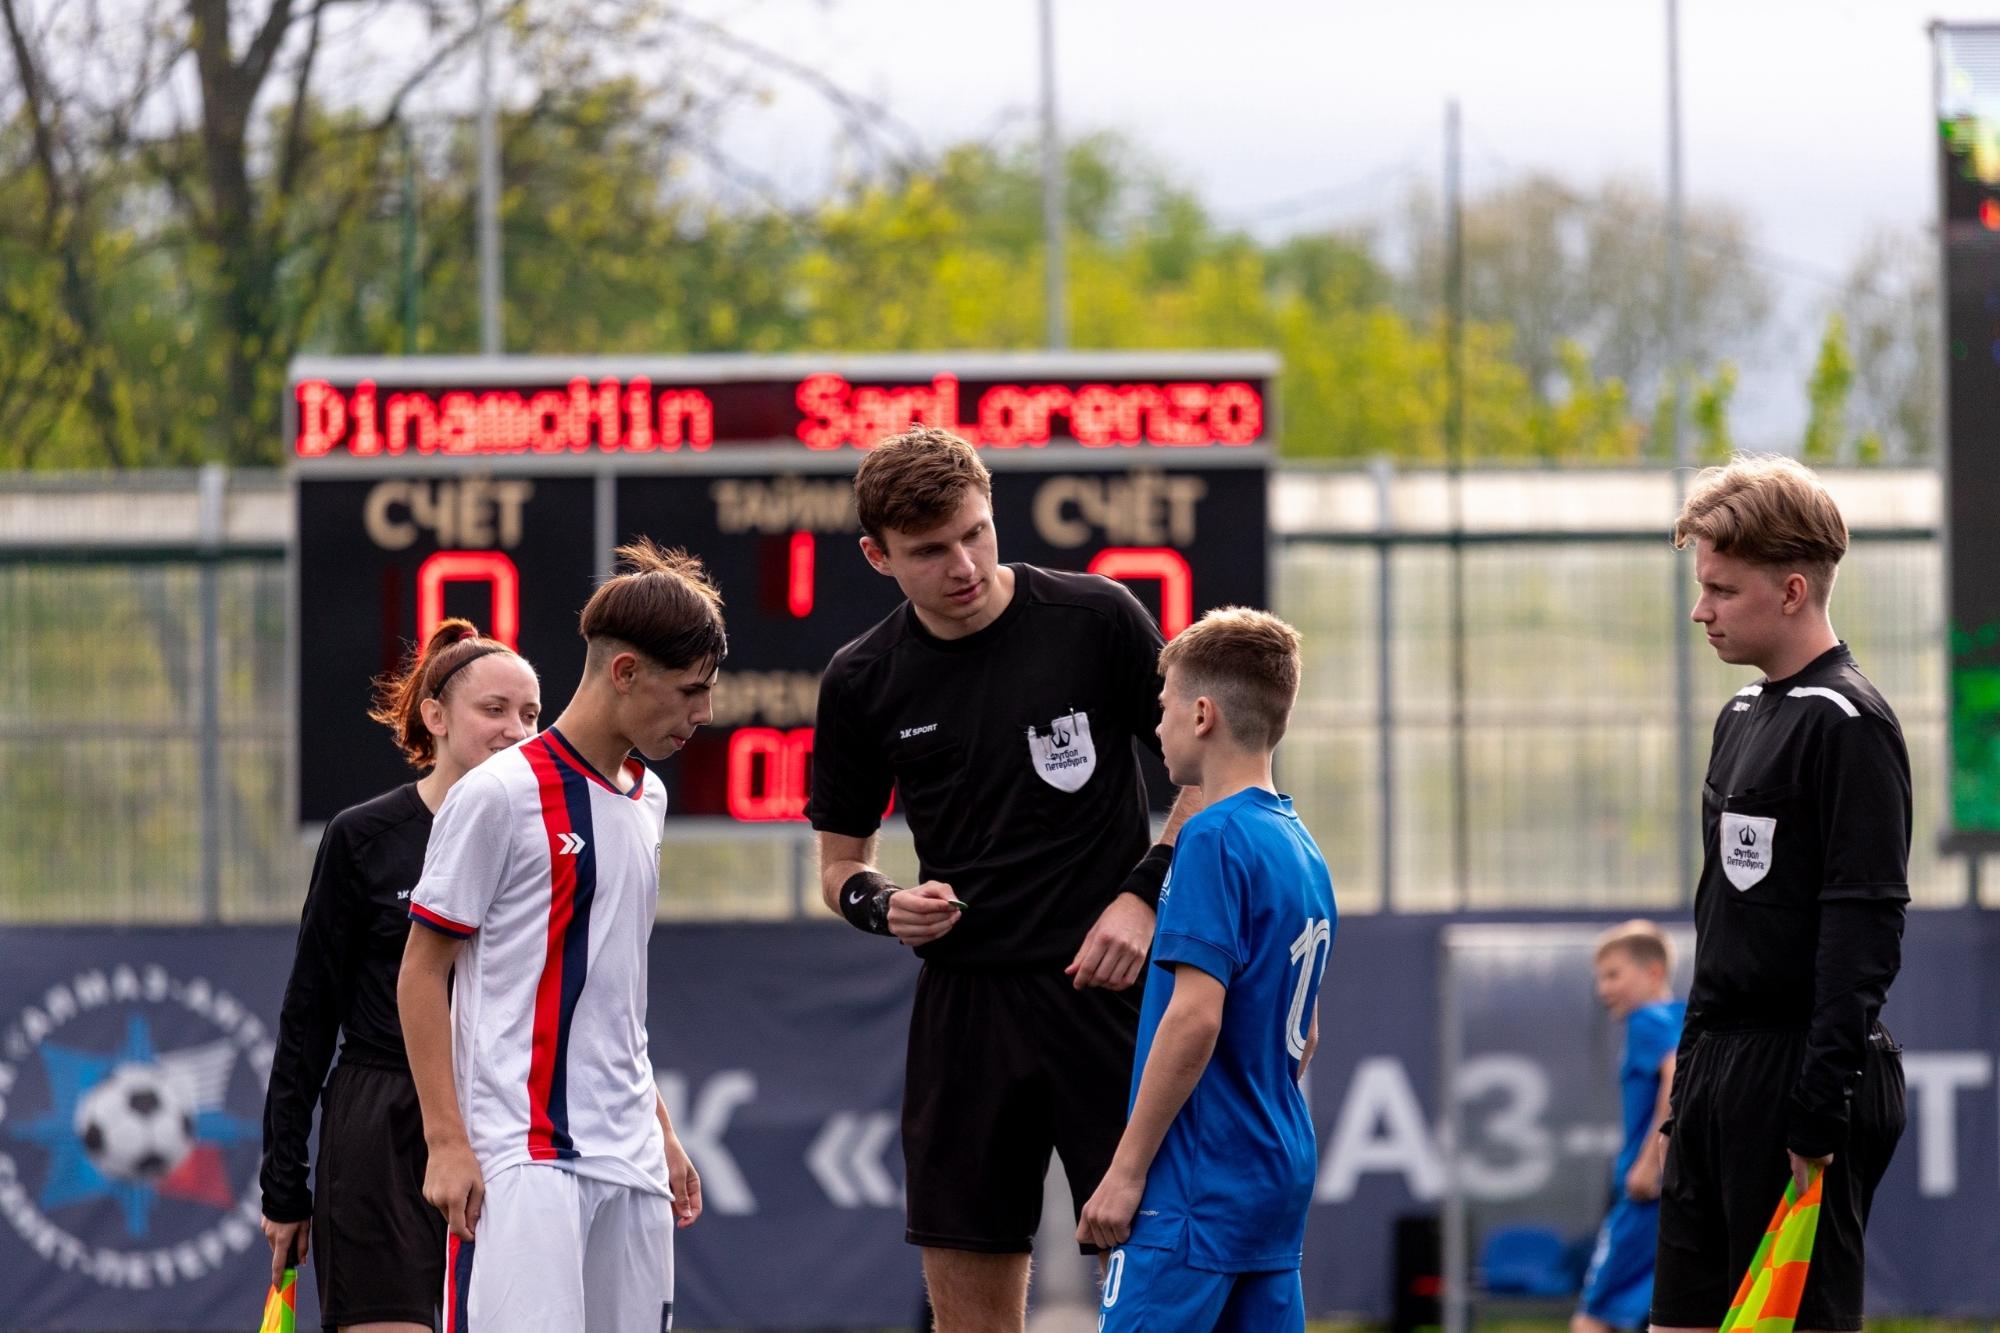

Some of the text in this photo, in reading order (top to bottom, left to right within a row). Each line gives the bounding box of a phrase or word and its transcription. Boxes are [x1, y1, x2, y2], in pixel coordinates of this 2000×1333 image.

[796, 372, 1263, 449] SanLorenzo
[364, 470, 535, 550] СЧЁТ
[1033, 468, 1206, 548] СЧЁТ
[912, 723, 938, 736] SPORT
[1045, 756, 1088, 771] Петербурга
[1726, 856, 1765, 870] Петербурга
[1733, 848, 1760, 860] Футбол
[1283, 917, 1331, 1061] 10
